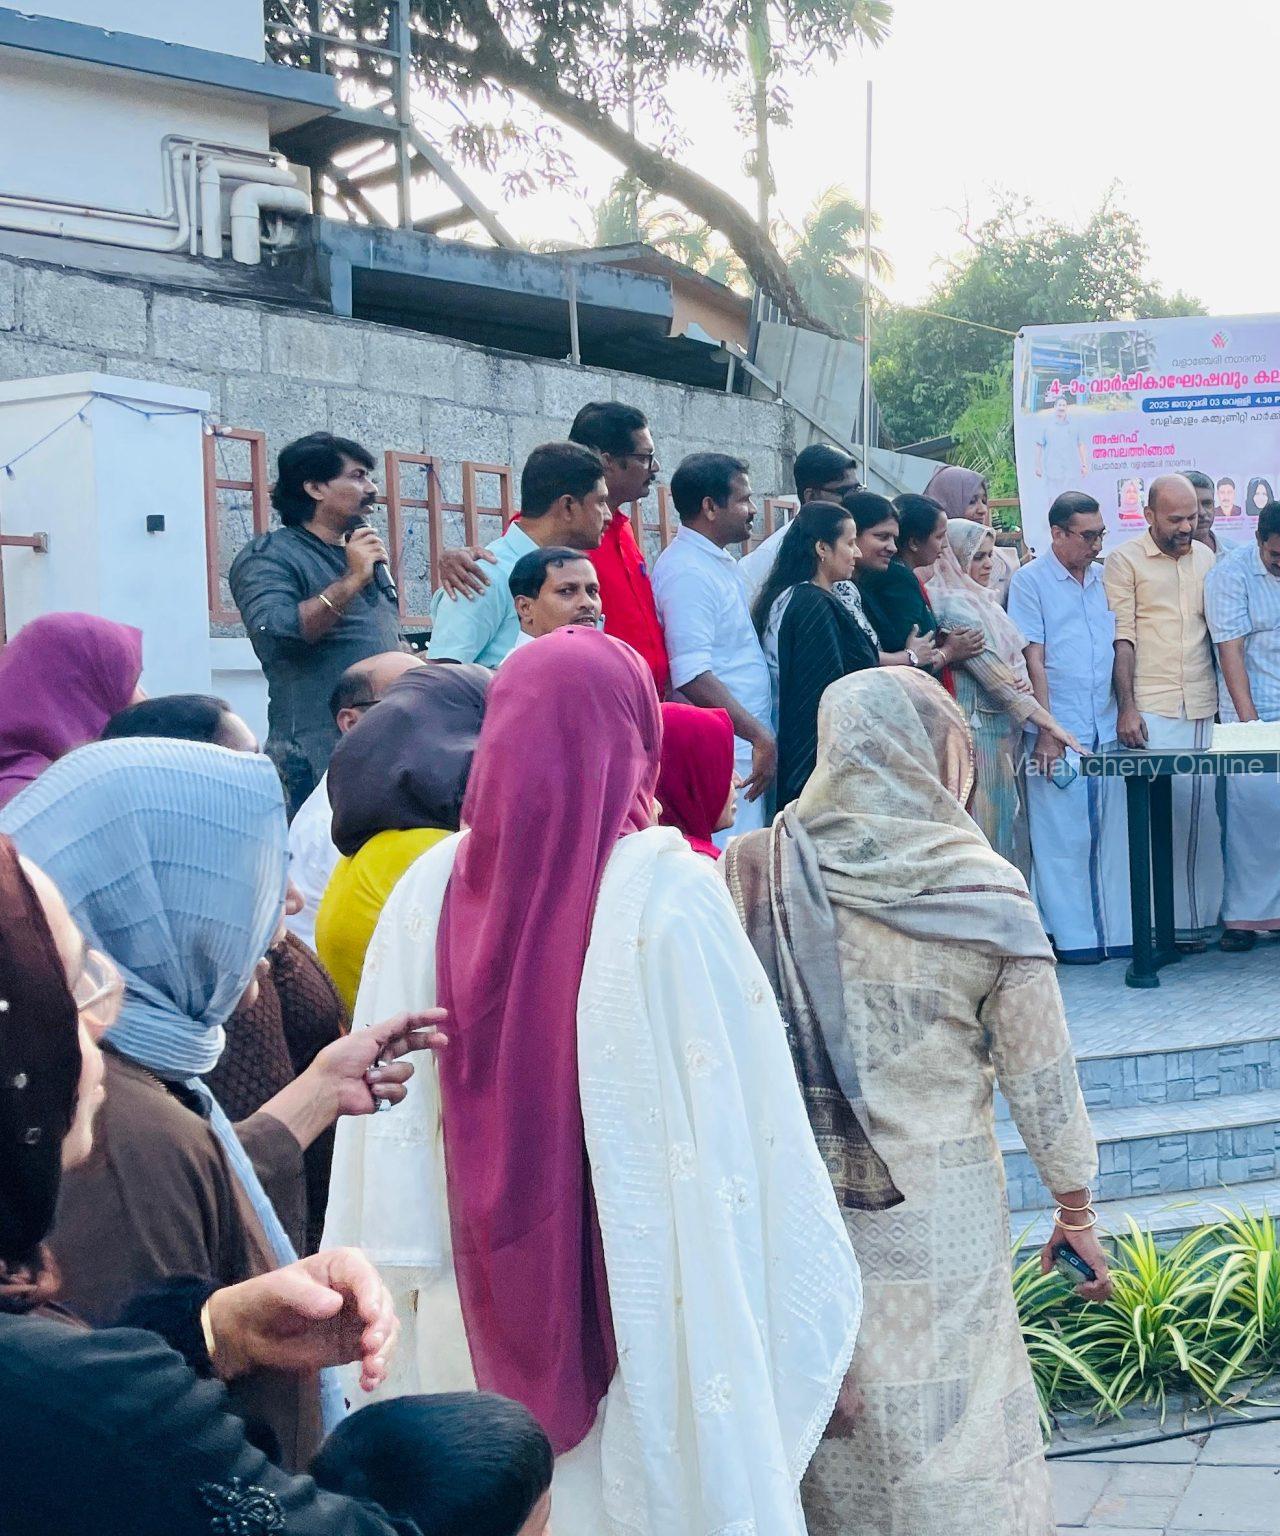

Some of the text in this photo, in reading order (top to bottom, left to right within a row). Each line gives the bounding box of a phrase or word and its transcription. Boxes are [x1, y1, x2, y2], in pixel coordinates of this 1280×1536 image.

[1090, 371, 1249, 393] വാർഷികാഘോഷവും
[1149, 401, 1169, 409] 2025
[1171, 398, 1208, 410] ജനുവരി
[1255, 396, 1272, 404] 4.30
[1092, 430, 1140, 445] അഷറഫ്
